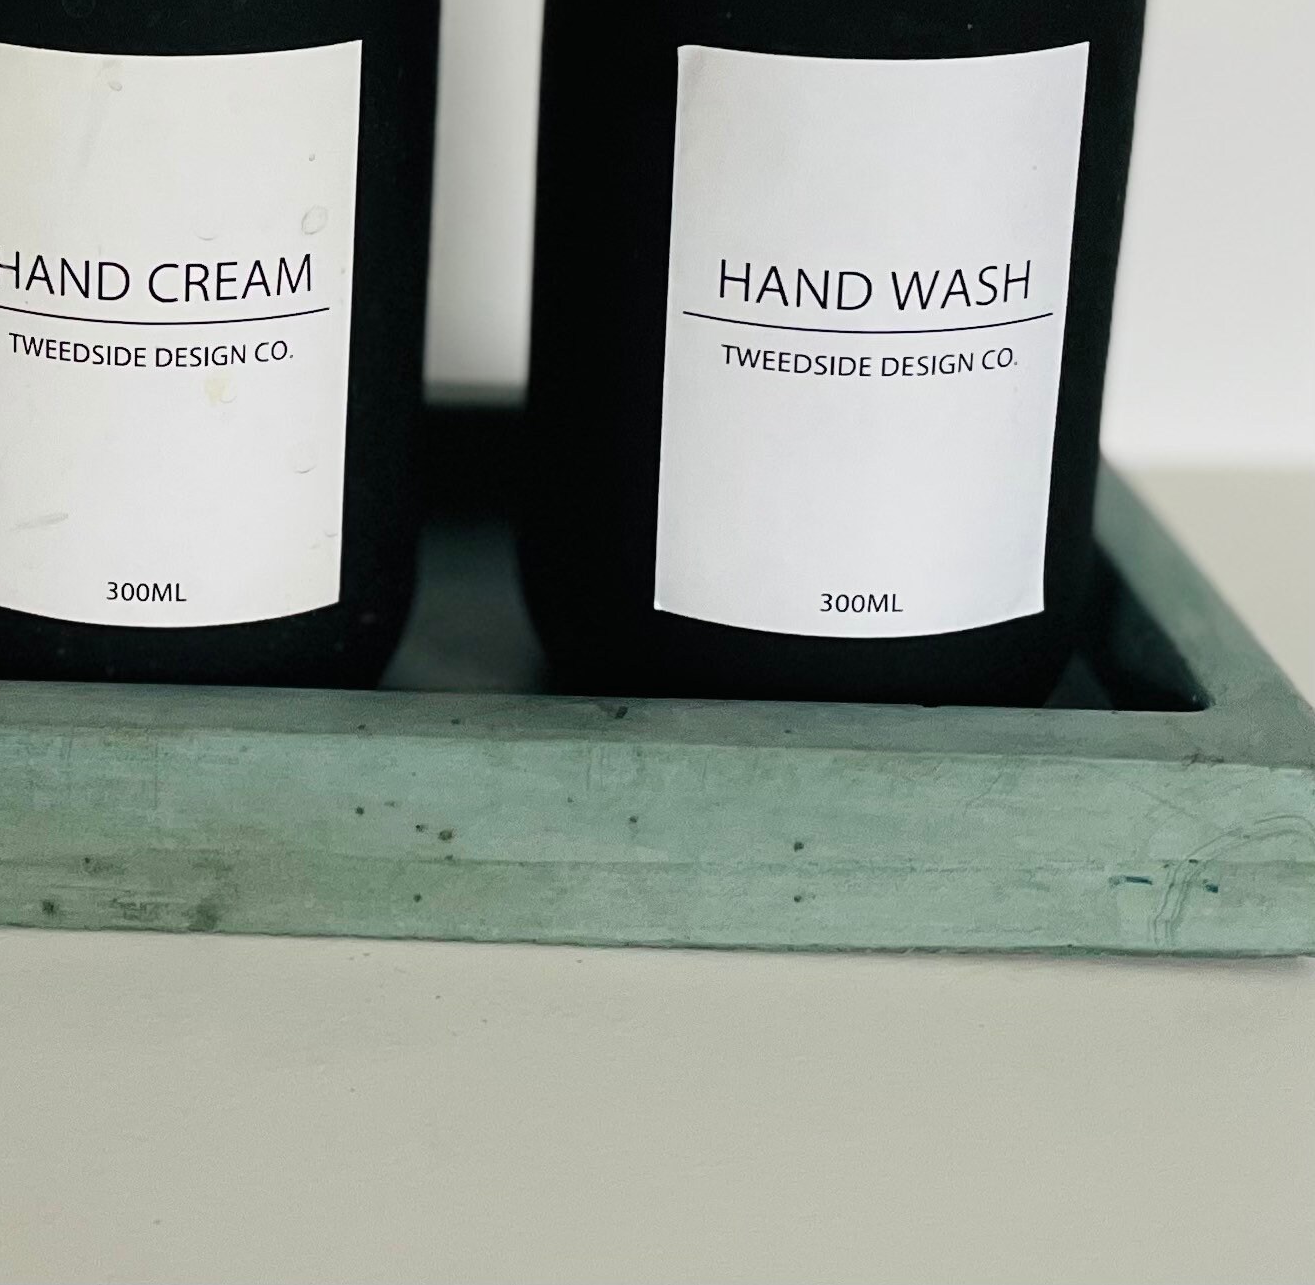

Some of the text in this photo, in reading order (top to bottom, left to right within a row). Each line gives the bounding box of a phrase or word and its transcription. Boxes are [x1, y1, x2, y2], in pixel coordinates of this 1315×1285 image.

[147, 253, 312, 304] CREAM
[718, 258, 1032, 311] HAND WASH
[8, 332, 294, 368] TWEEDSIDE DESIGN CO.
[721, 343, 1019, 377] TWEEDSIDE DESIGN CO.
[106, 581, 187, 602] 300ML
[820, 593, 903, 613] 300ML
